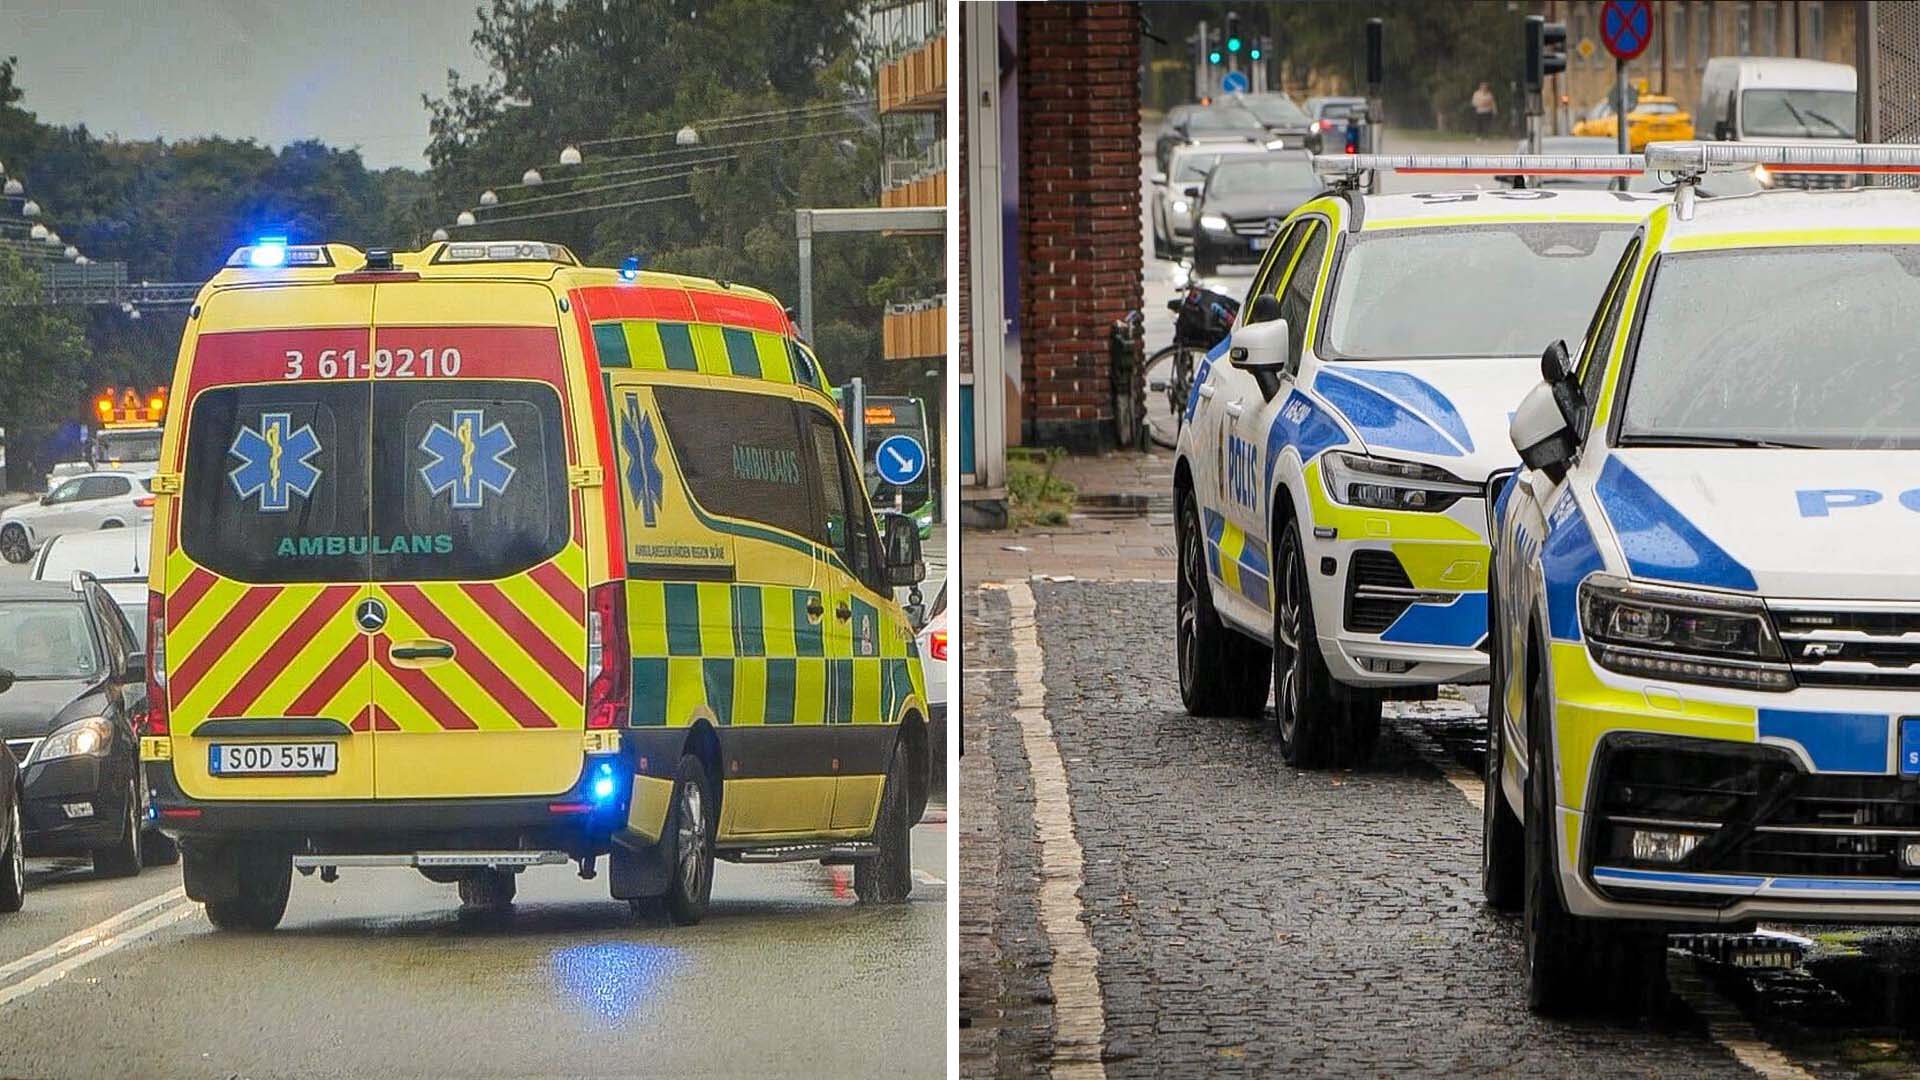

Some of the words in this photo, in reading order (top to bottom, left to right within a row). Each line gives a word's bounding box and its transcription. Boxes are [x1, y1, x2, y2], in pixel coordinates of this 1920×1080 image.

[284, 350, 304, 379] 3
[318, 348, 462, 378] 61-9210
[732, 445, 799, 485] AMBULANS
[1228, 435, 1257, 512] POLIS
[277, 534, 454, 556] AMBULANS
[229, 747, 272, 769] SOD
[280, 746, 326, 768] 55W
[1909, 751, 1919, 765] S
